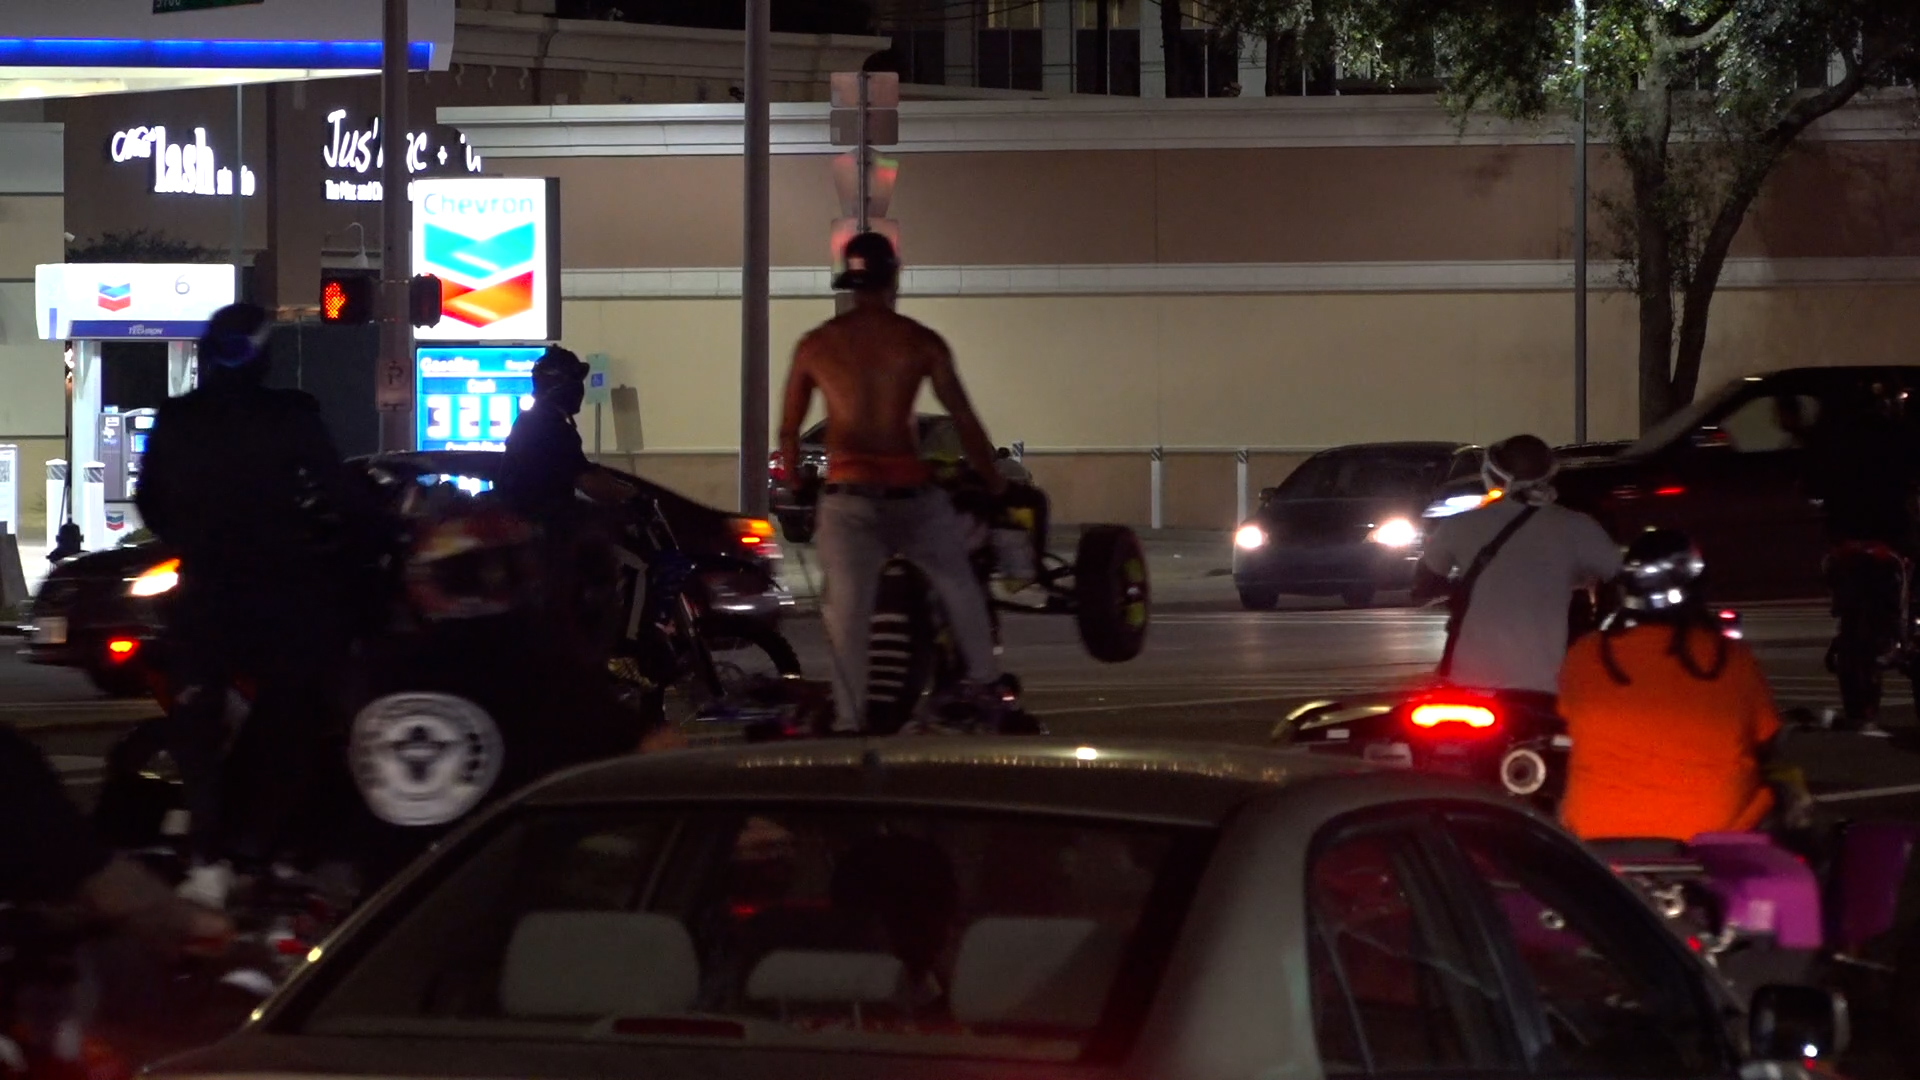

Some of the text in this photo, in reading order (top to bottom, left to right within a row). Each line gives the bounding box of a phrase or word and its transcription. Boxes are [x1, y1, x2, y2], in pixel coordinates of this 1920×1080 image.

[154, 126, 215, 195] lash
[423, 192, 535, 217] Chevron
[174, 274, 190, 295] 6
